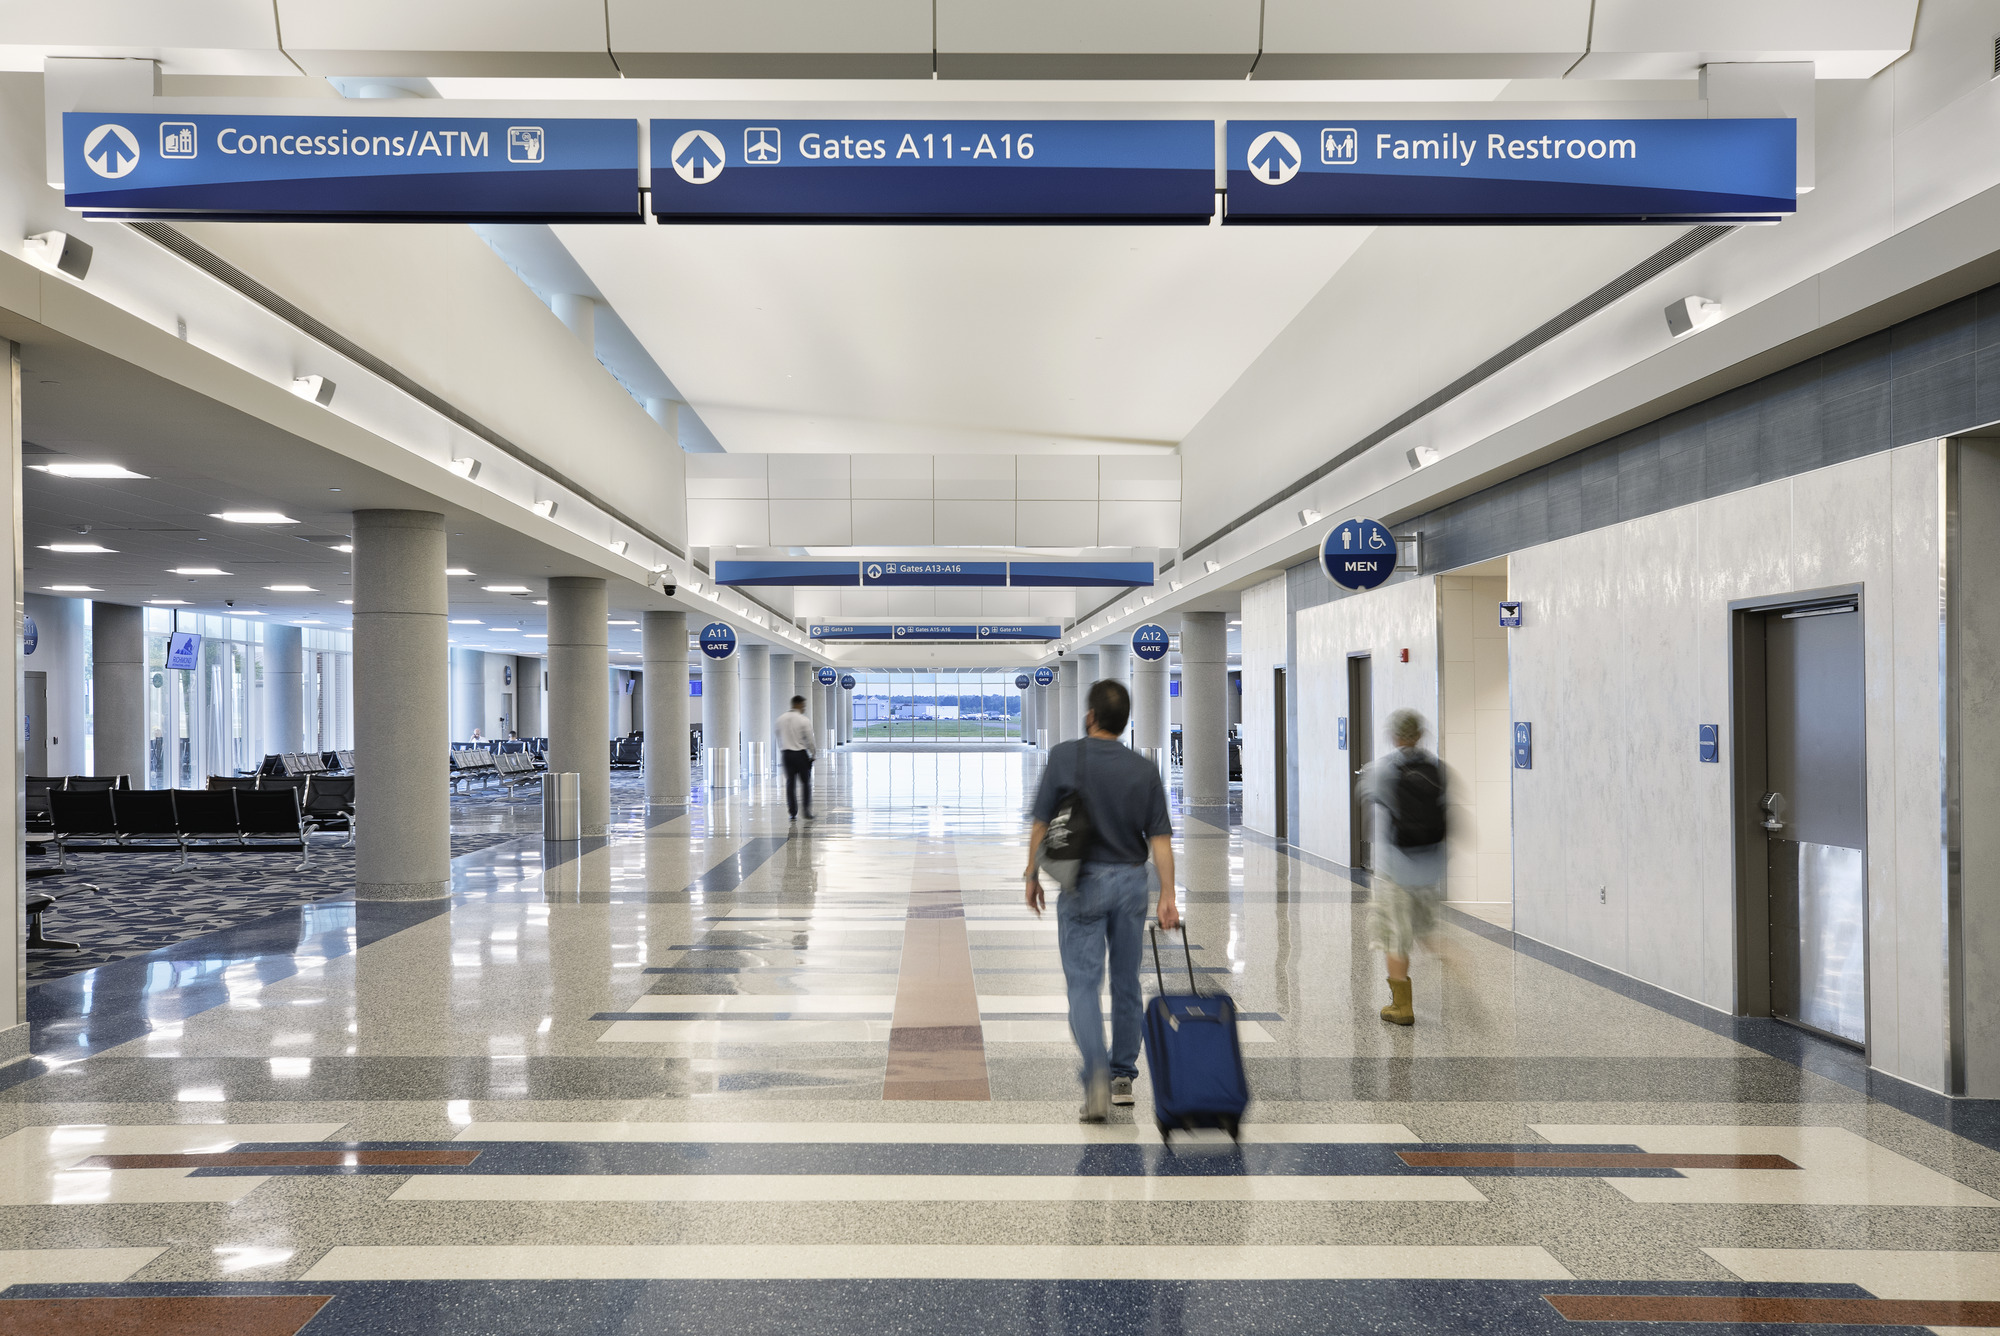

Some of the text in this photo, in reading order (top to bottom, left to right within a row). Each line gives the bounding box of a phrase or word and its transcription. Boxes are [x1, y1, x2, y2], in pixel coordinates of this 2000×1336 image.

[217, 127, 489, 158] Concessions/ATM
[799, 132, 1035, 160] Gates A11-A16
[1376, 132, 1637, 168] Family Restroom
[899, 564, 962, 573] Gates A13-A16
[1344, 561, 1378, 572] MEN
[708, 628, 727, 638] A11
[1140, 631, 1161, 641] A12
[707, 643, 729, 651] GATE
